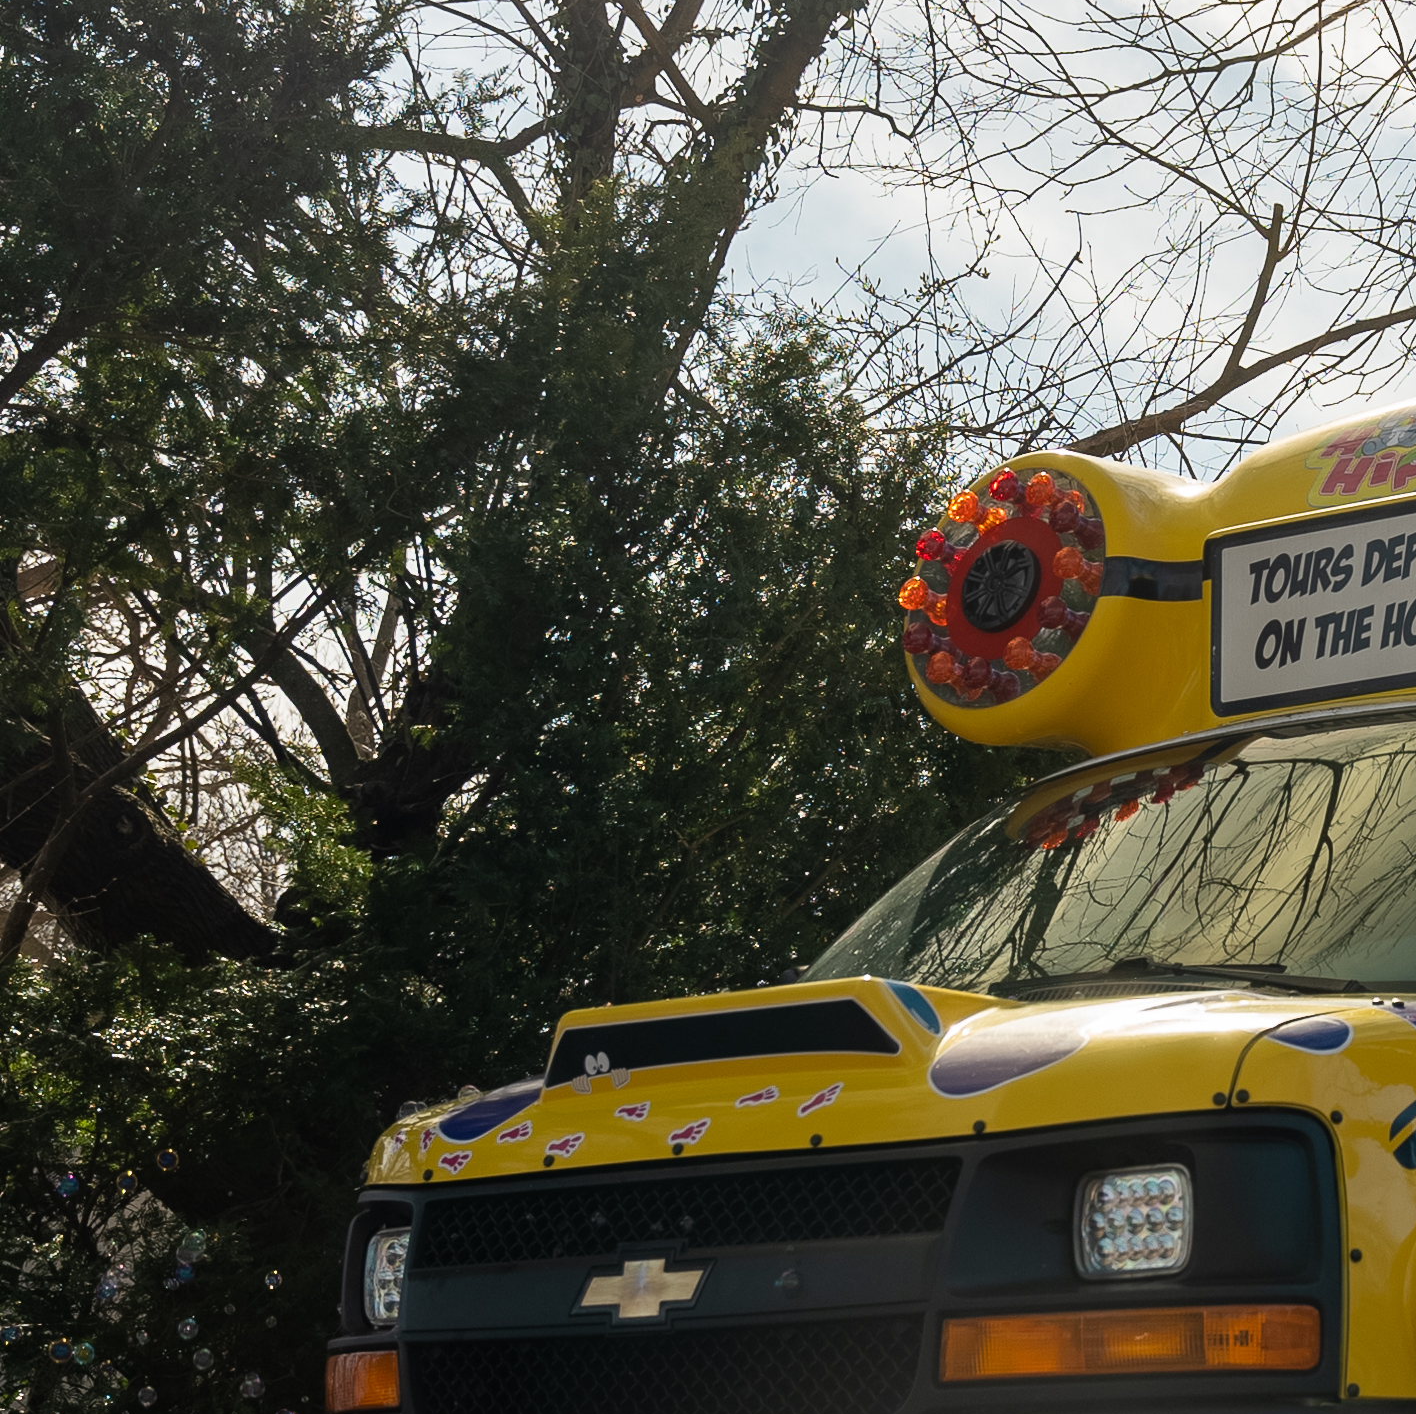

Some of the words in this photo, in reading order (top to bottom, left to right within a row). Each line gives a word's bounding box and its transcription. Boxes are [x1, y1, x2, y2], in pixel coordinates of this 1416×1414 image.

[1249, 543, 1354, 605] TOURS
[1254, 617, 1307, 670] ON
[1314, 604, 1375, 660] THE
